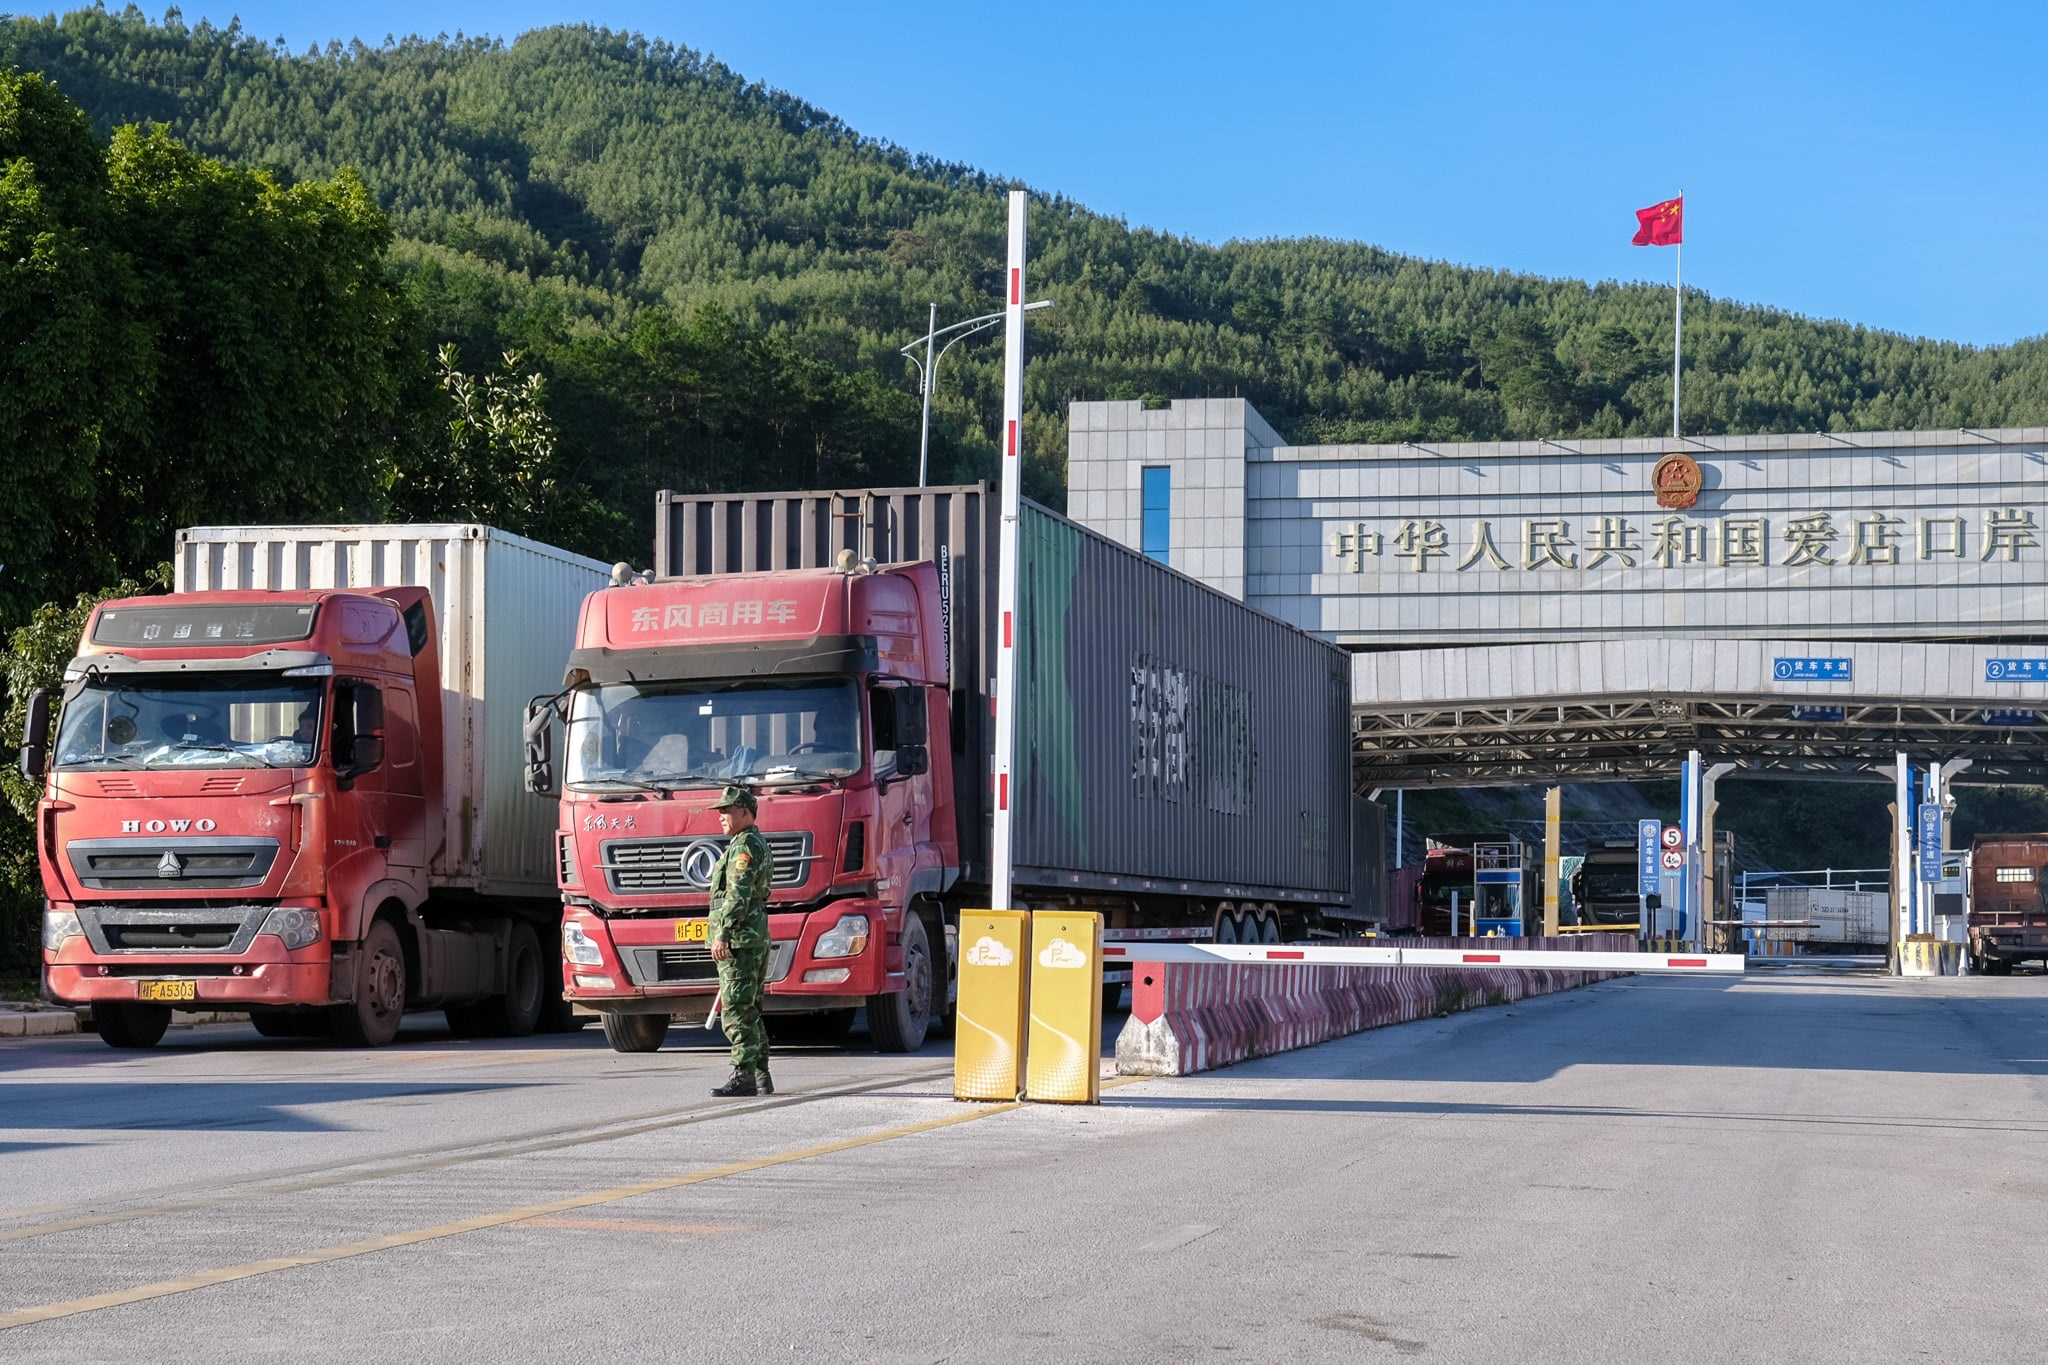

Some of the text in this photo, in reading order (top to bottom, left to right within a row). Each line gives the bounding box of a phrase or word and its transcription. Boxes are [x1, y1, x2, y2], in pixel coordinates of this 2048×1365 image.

[1334, 507, 2041, 573] 中华人民共和国爱店口岸
[632, 599, 798, 632] 东风商用车
[1794, 661, 1847, 671] 货车车道
[121, 819, 217, 833] HOWO
[1668, 830, 1677, 844] 5
[1926, 822, 1935, 859] 货车车道
[1645, 838, 1654, 874] 货车车道
